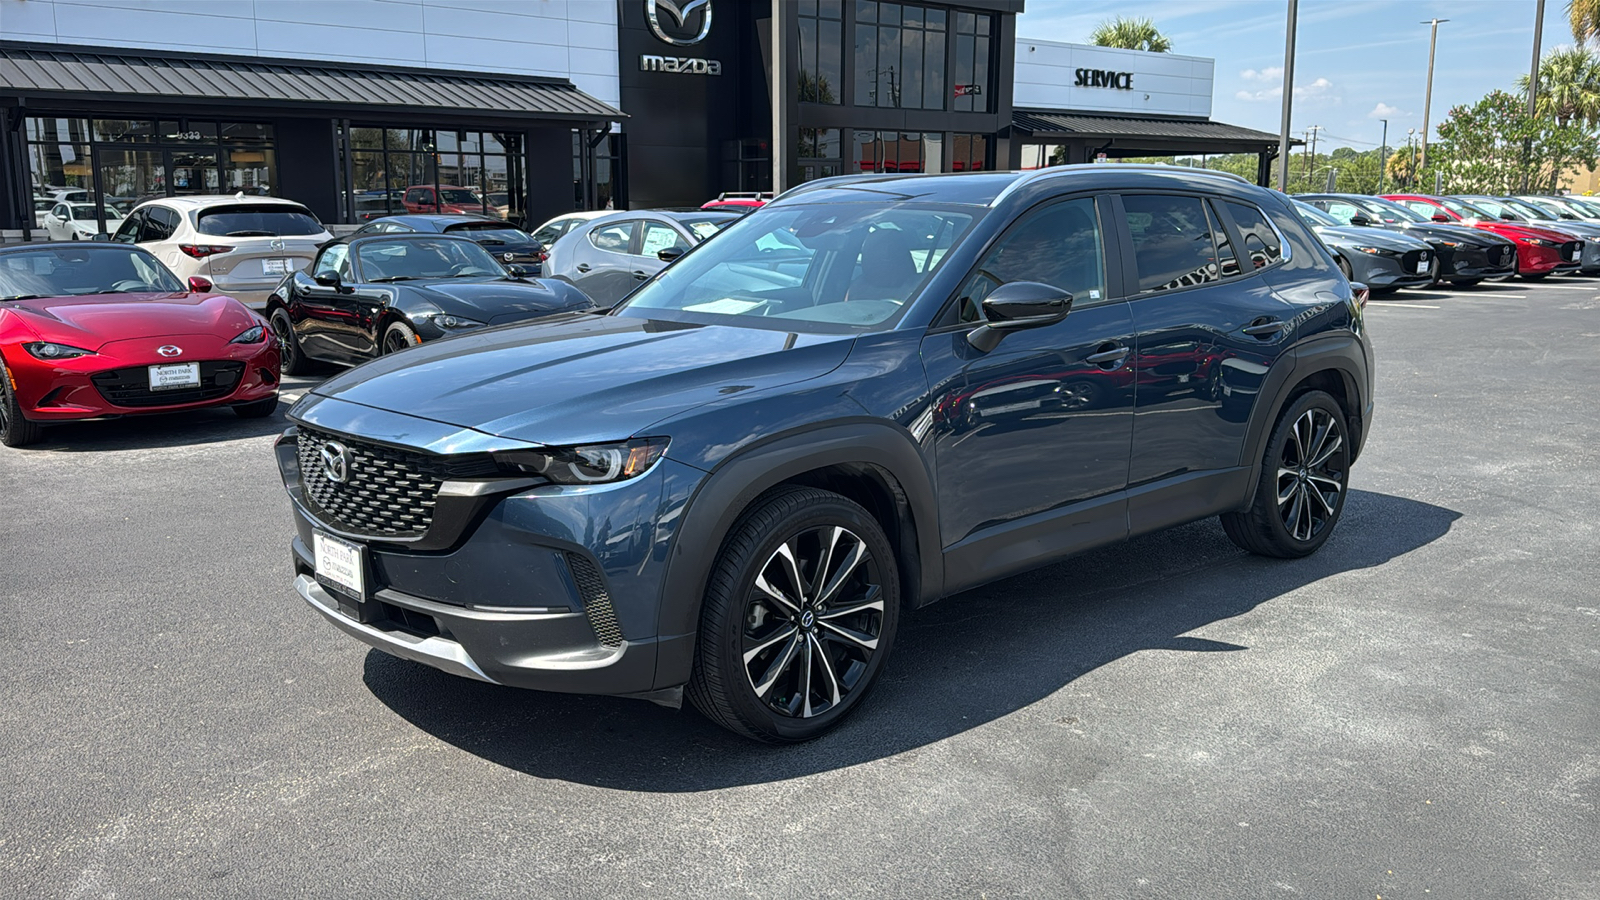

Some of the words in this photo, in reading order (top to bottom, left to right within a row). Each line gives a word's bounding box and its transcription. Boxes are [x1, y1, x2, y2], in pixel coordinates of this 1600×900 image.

[640, 54, 722, 75] mazda
[1074, 68, 1134, 90] SERVICE
[320, 542, 339, 559] NORTH
[339, 550, 355, 566] PARK
